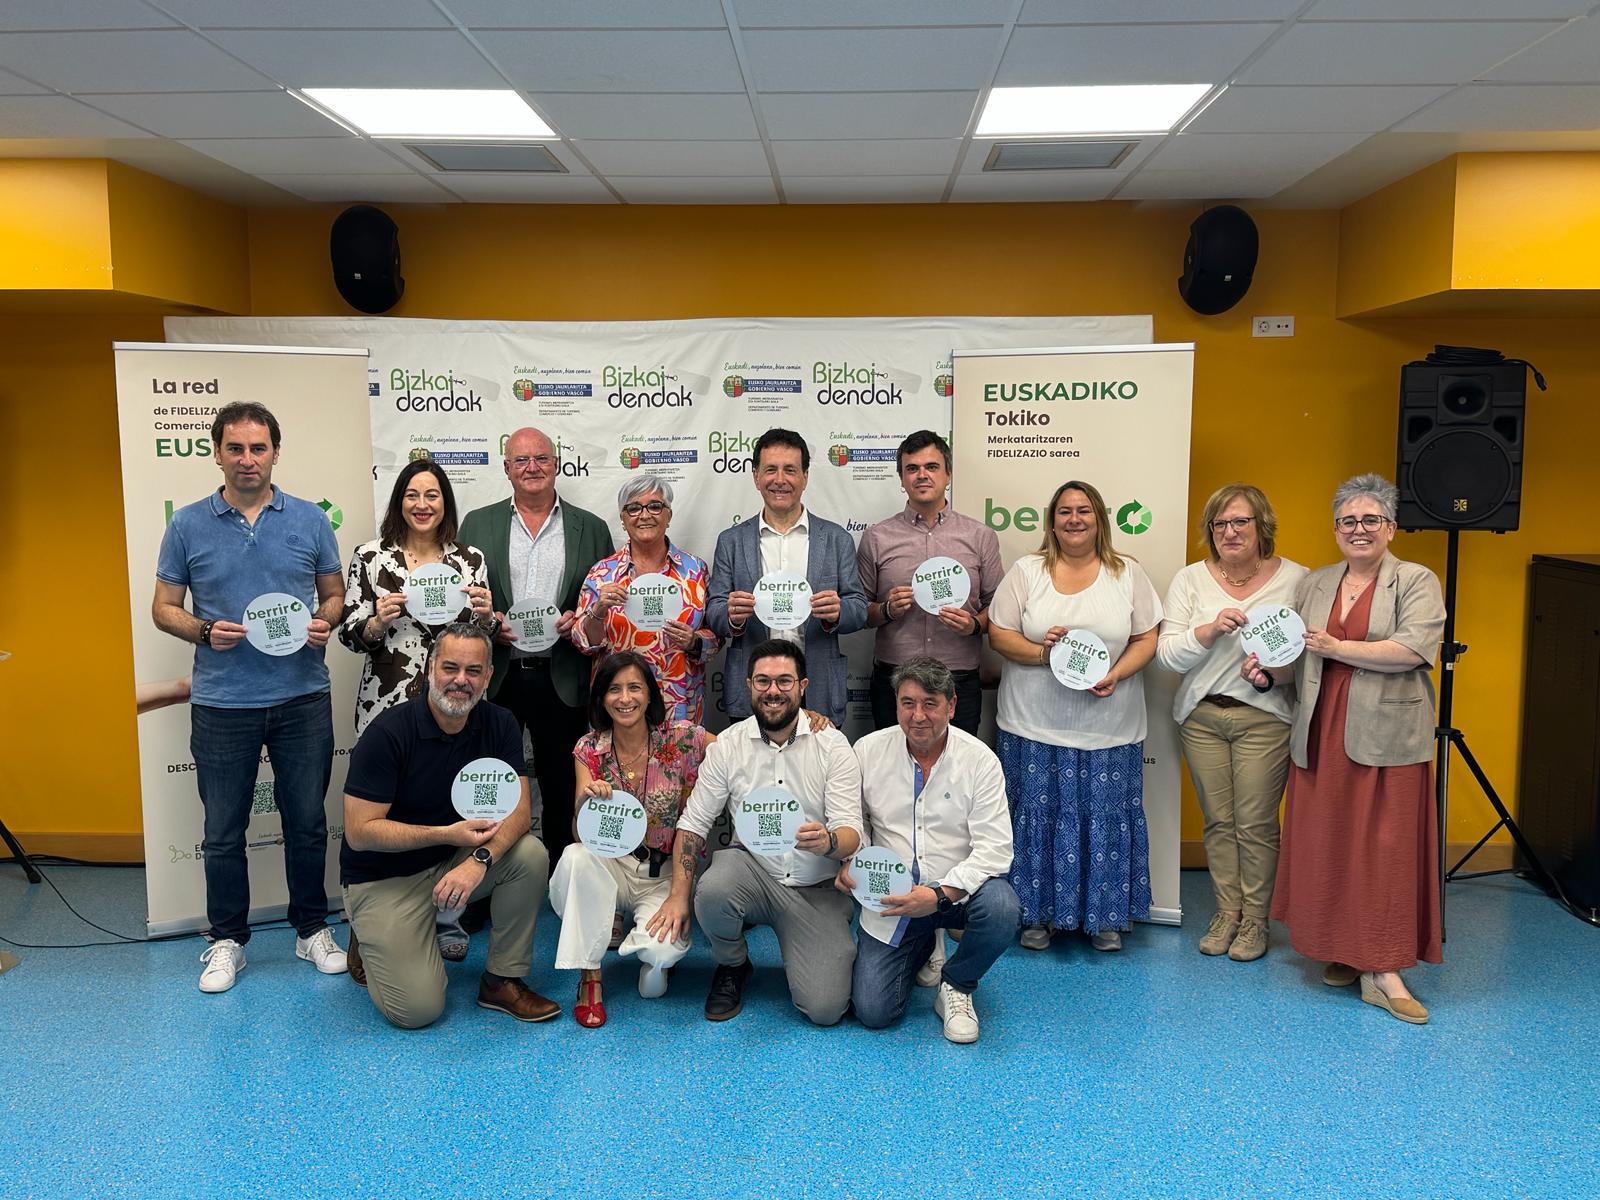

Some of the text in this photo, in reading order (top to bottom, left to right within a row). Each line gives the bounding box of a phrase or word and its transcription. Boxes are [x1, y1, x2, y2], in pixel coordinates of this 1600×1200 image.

[390, 368, 453, 391] Bizkai
[603, 365, 665, 387] Bizkai
[812, 361, 875, 384] Bizkai
[152, 378, 219, 395] La red
[608, 385, 693, 408] dendak
[817, 382, 903, 405] dendak
[984, 381, 1138, 402] EUSKADIKO
[396, 389, 482, 412] dendak
[153, 406, 225, 416] de FIDELIZAC
[985, 409, 1050, 426] Tokiko
[154, 420, 212, 430] Comercio
[156, 438, 212, 457] EUS
[708, 430, 760, 453] Bizk
[987, 434, 1073, 444] Merkataritzaren
[713, 451, 754, 473] den
[987, 449, 1080, 458] FIDELIZAZIO sarea
[846, 518, 868, 531] bien
[167, 762, 197, 773] DESC
